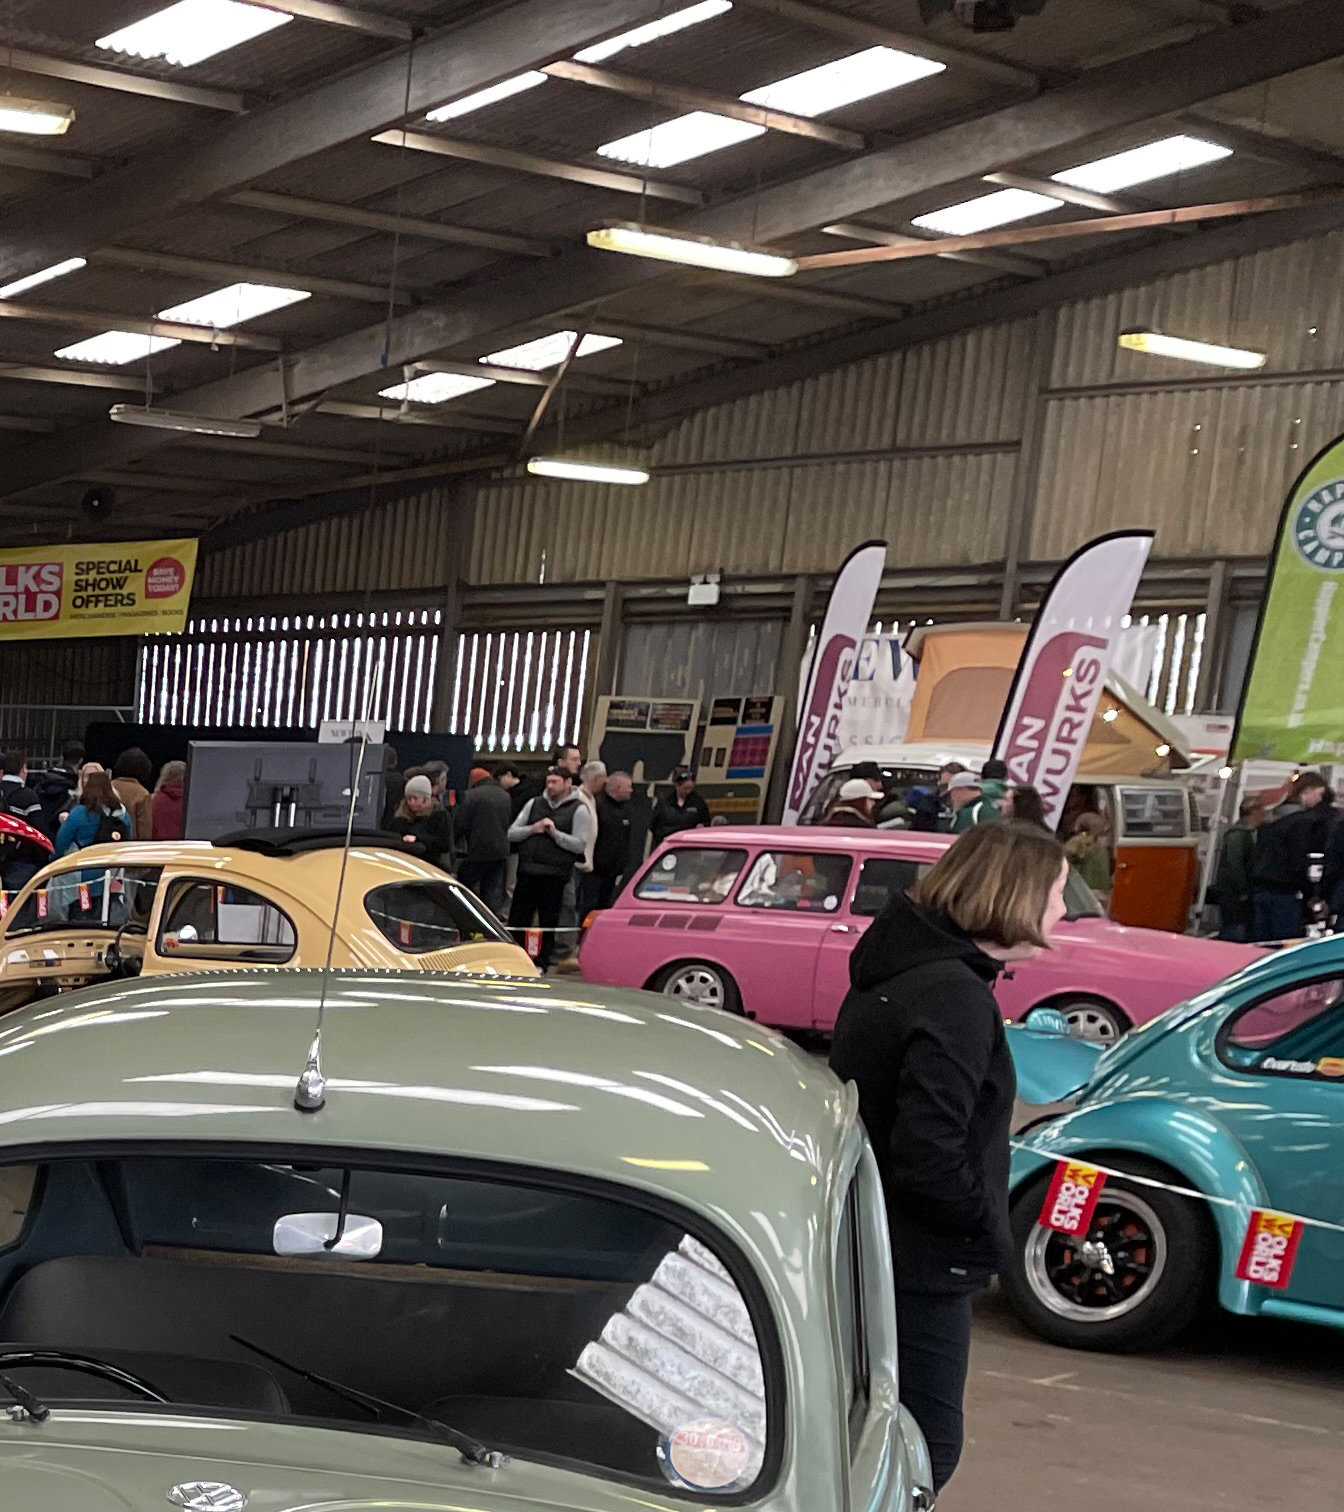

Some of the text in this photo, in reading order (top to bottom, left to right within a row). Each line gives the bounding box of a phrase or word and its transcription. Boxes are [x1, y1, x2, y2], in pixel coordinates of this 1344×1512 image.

[74, 559, 143, 576] SPECIAL
[73, 575, 129, 593] SHOW
[72, 591, 137, 609] OFFERS
[1063, 1172, 1095, 1231] VOLKS
[1262, 1221, 1293, 1282] VOLKS
